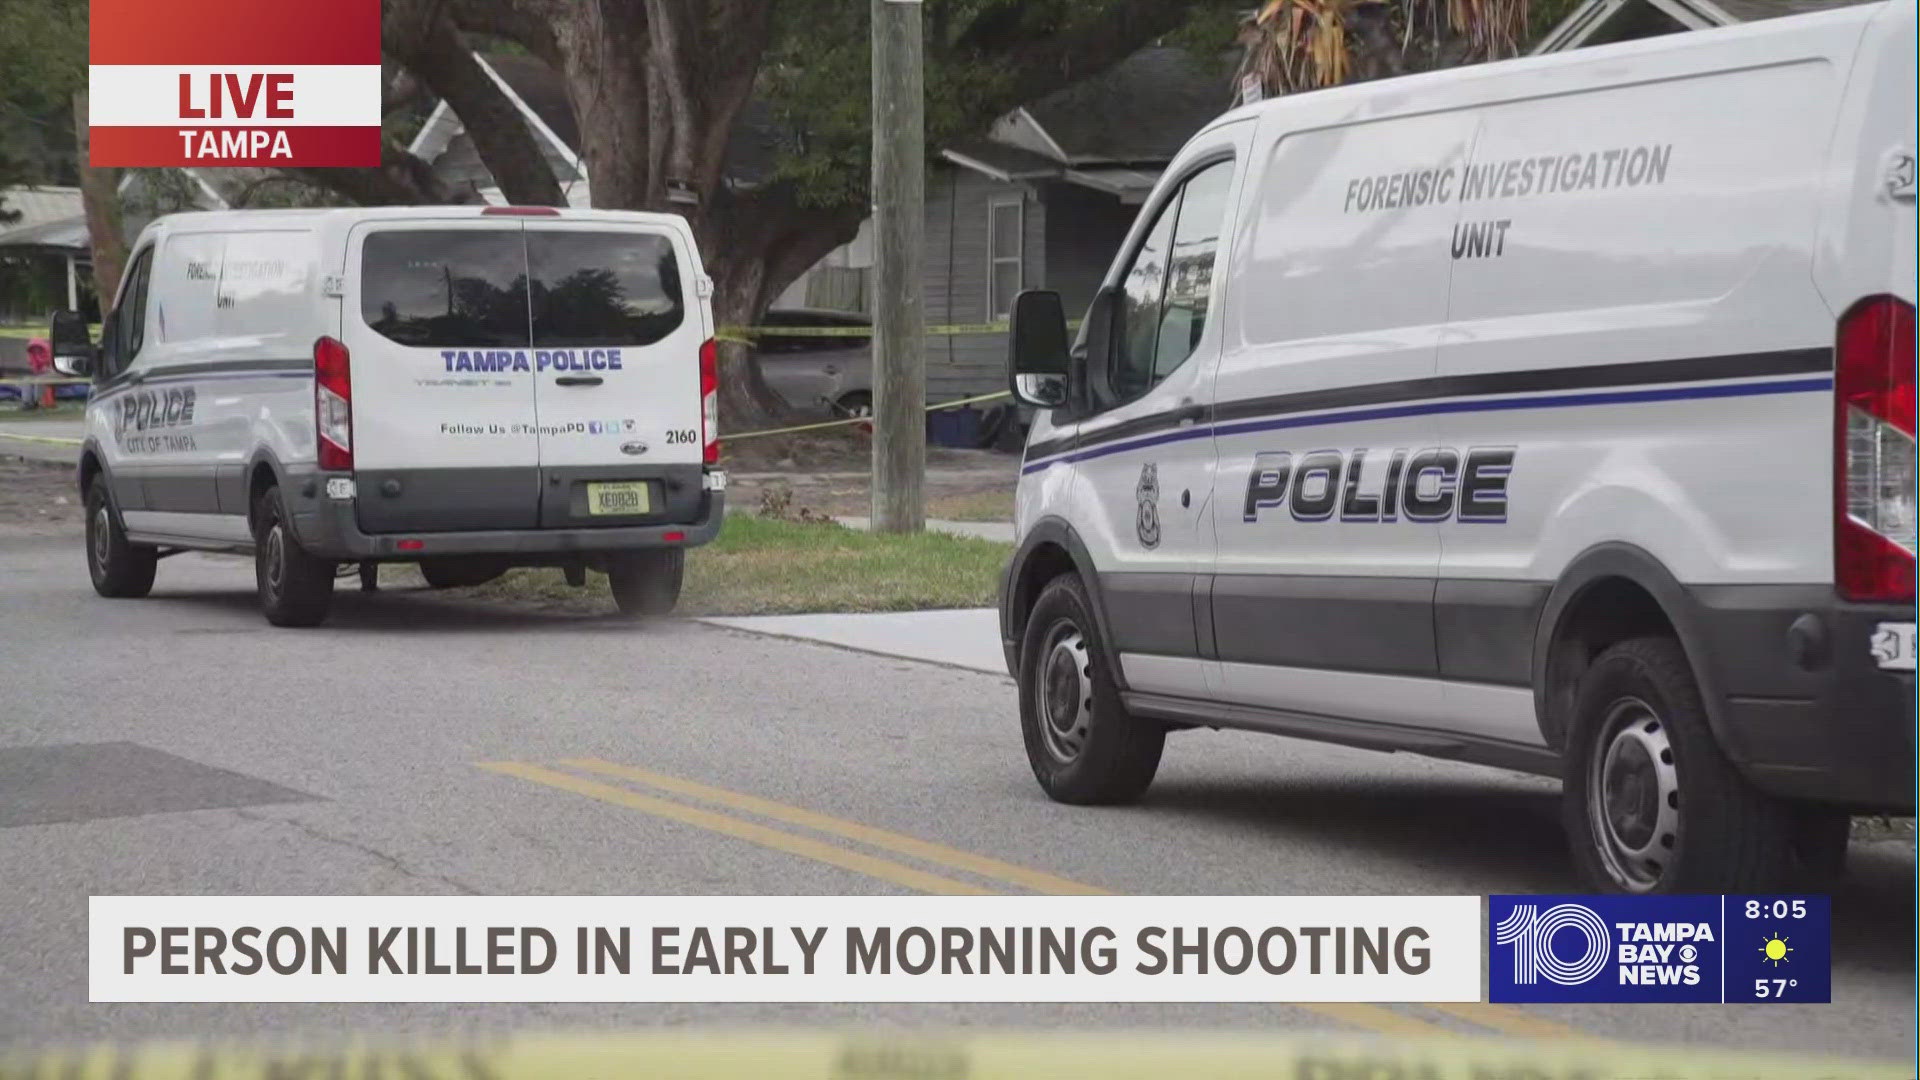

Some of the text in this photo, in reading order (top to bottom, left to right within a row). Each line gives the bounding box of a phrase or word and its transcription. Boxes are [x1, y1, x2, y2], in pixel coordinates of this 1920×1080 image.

[1344, 143, 1672, 214] FORENSIC INVESTIGATION
[1451, 220, 1512, 260] UNIT
[441, 350, 623, 372] TAMPA POLICE
[123, 386, 196, 432] POLICE
[148, 437, 161, 453] OF
[163, 435, 198, 452] TAMPA
[440, 423, 585, 436] Follow Us @TampaPD
[666, 429, 697, 444] 2160
[1243, 445, 1518, 524] POLICE
